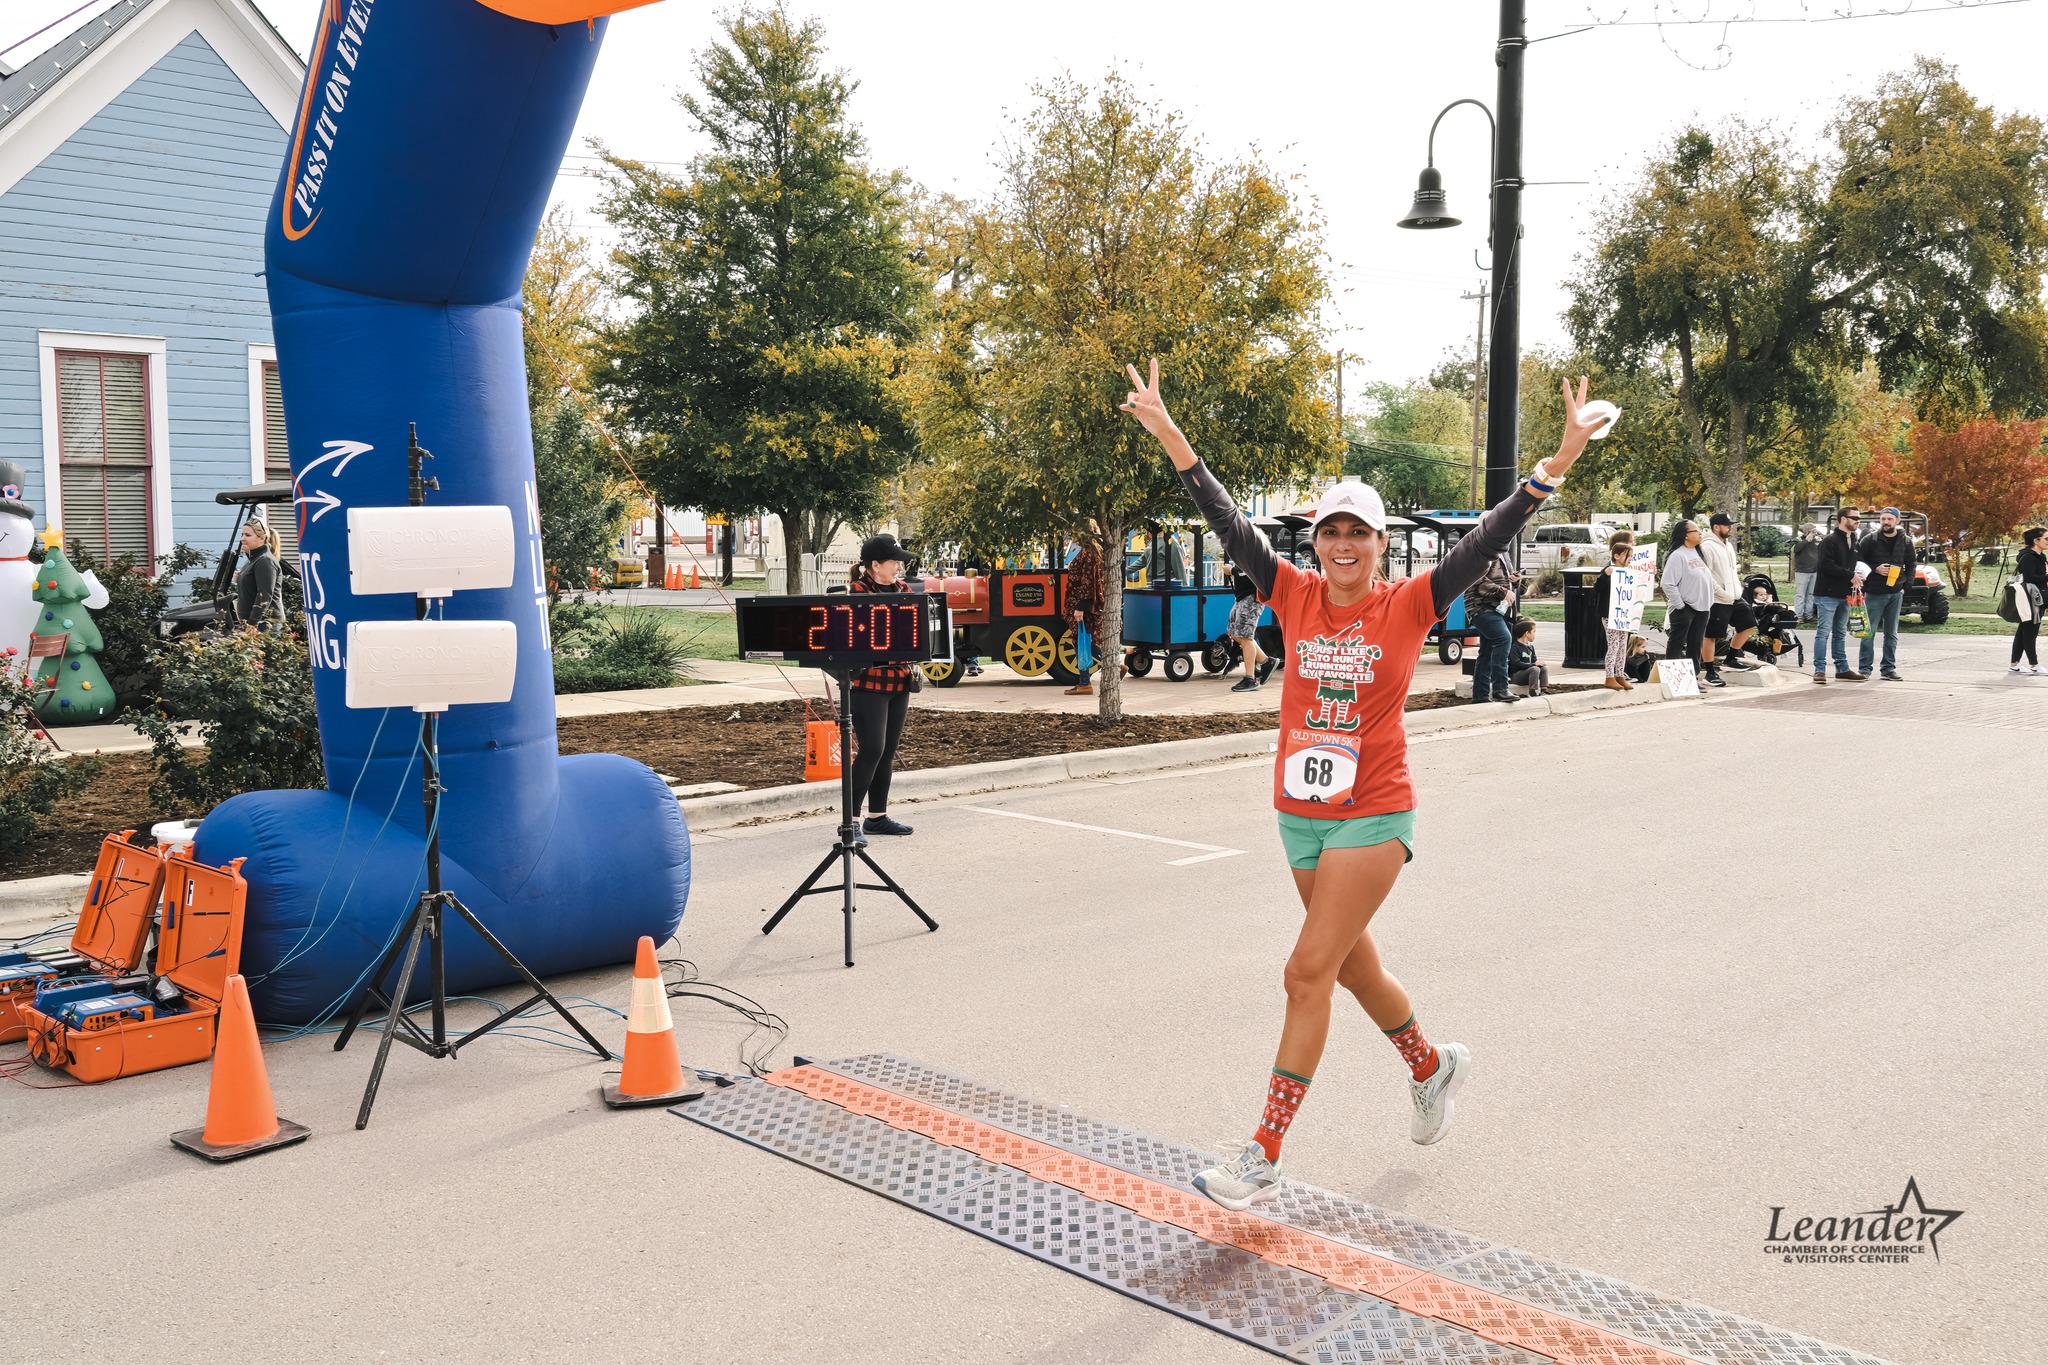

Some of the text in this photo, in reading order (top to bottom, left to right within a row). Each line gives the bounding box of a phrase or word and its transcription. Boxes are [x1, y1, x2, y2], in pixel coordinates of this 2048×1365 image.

[325, 61, 351, 113] ON
[315, 105, 338, 151] IT
[294, 139, 328, 218] PASS
[391, 528, 510, 545] CHRONOTRACK
[1615, 569, 1634, 585] The
[1615, 585, 1633, 606] You
[1307, 644, 1366, 656] I JUST LIKE
[1306, 660, 1364, 673] RUNNING'S
[1316, 654, 1354, 664] TO RUN
[1300, 667, 1372, 681] MY FAVORITE
[1292, 730, 1355, 747] OLD TOWN 5K
[1303, 756, 1334, 787] 68
